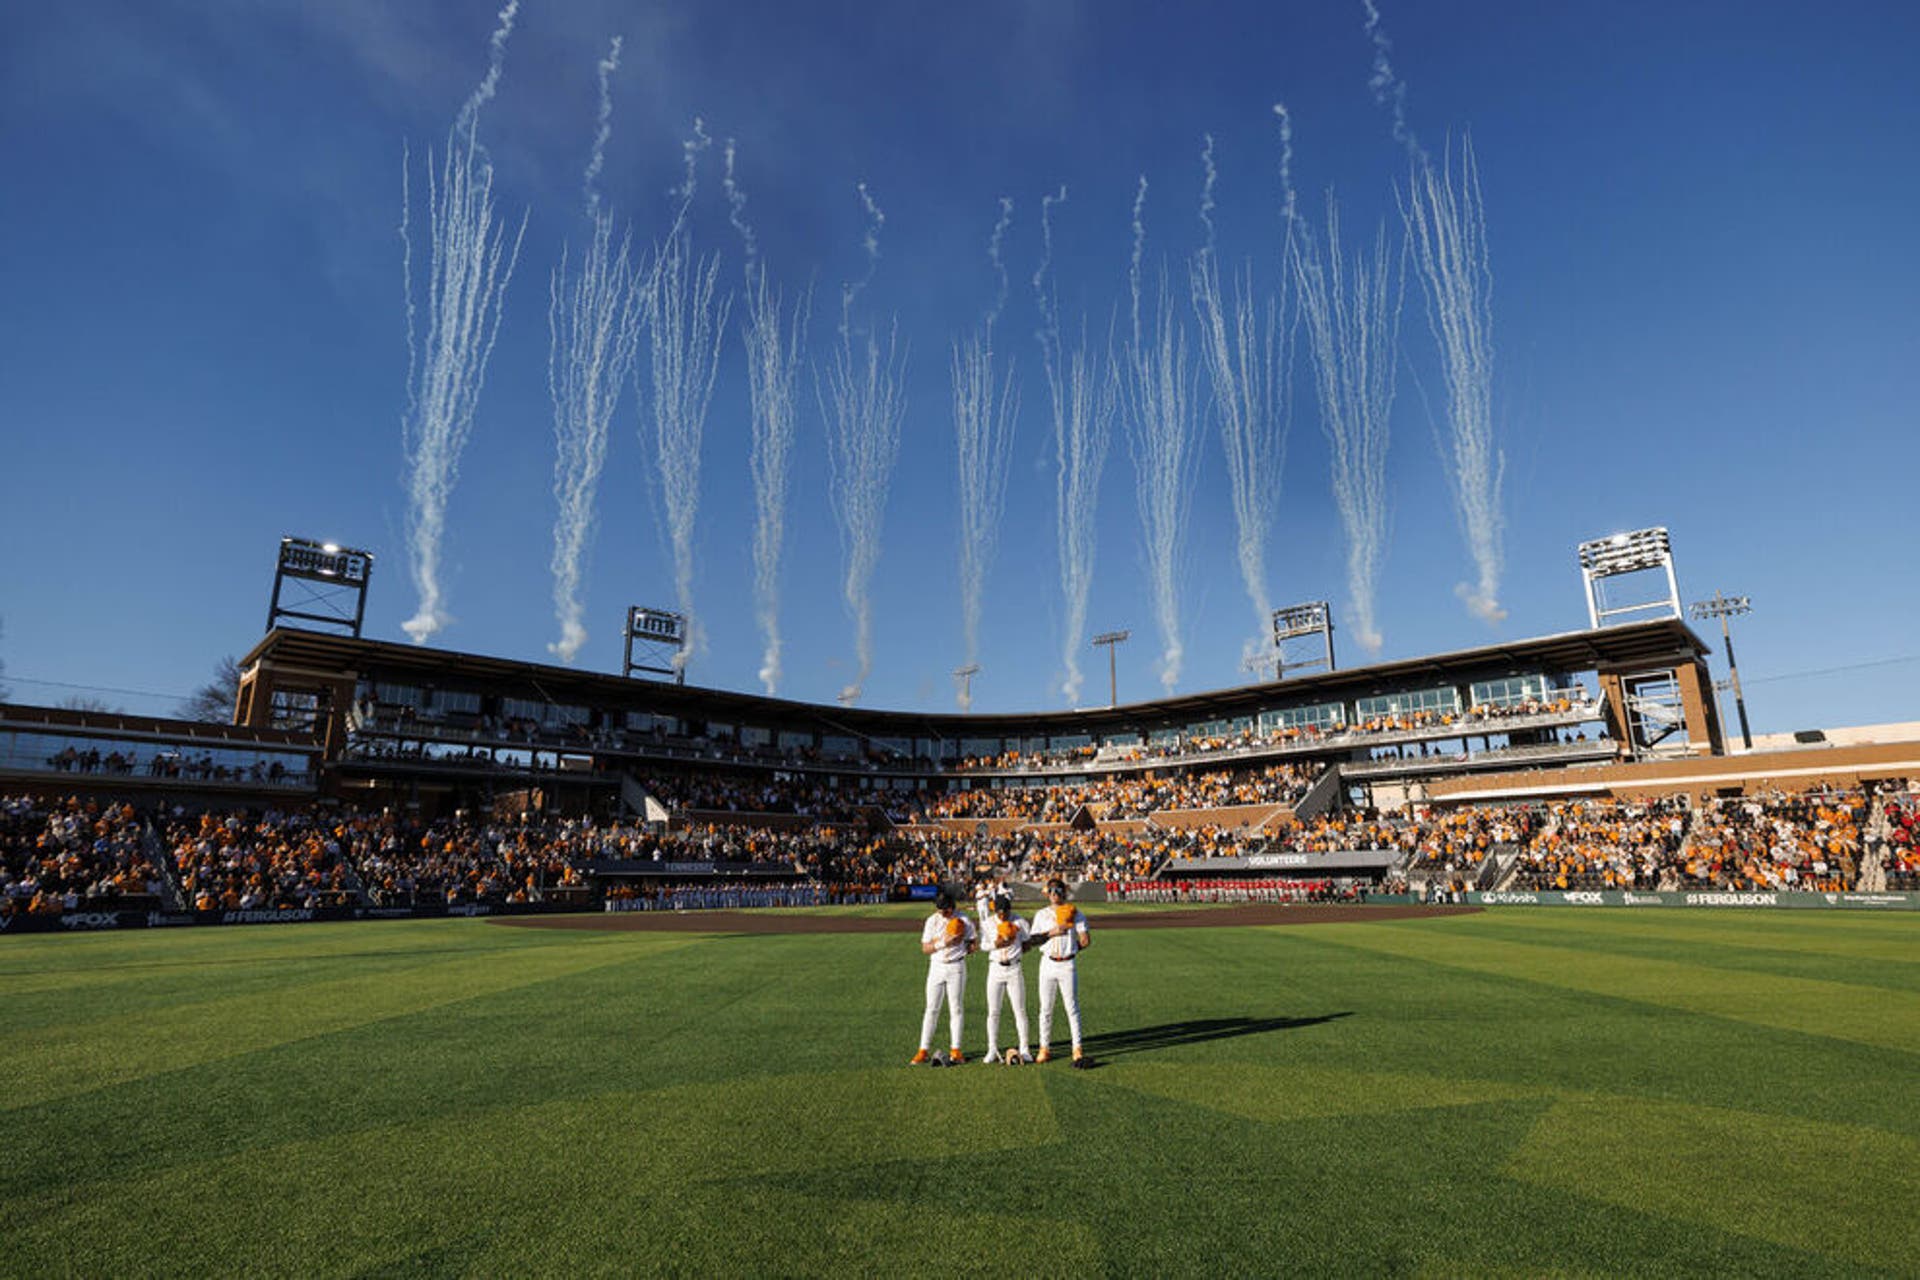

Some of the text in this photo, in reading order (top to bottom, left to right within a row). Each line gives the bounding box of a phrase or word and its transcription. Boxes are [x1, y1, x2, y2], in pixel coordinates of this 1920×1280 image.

[1248, 855, 1307, 866] VOLUNTEERS
[1698, 893, 1776, 905] FERGUSON
[74, 912, 119, 926] FOX
[238, 909, 313, 922] FERGUSON
